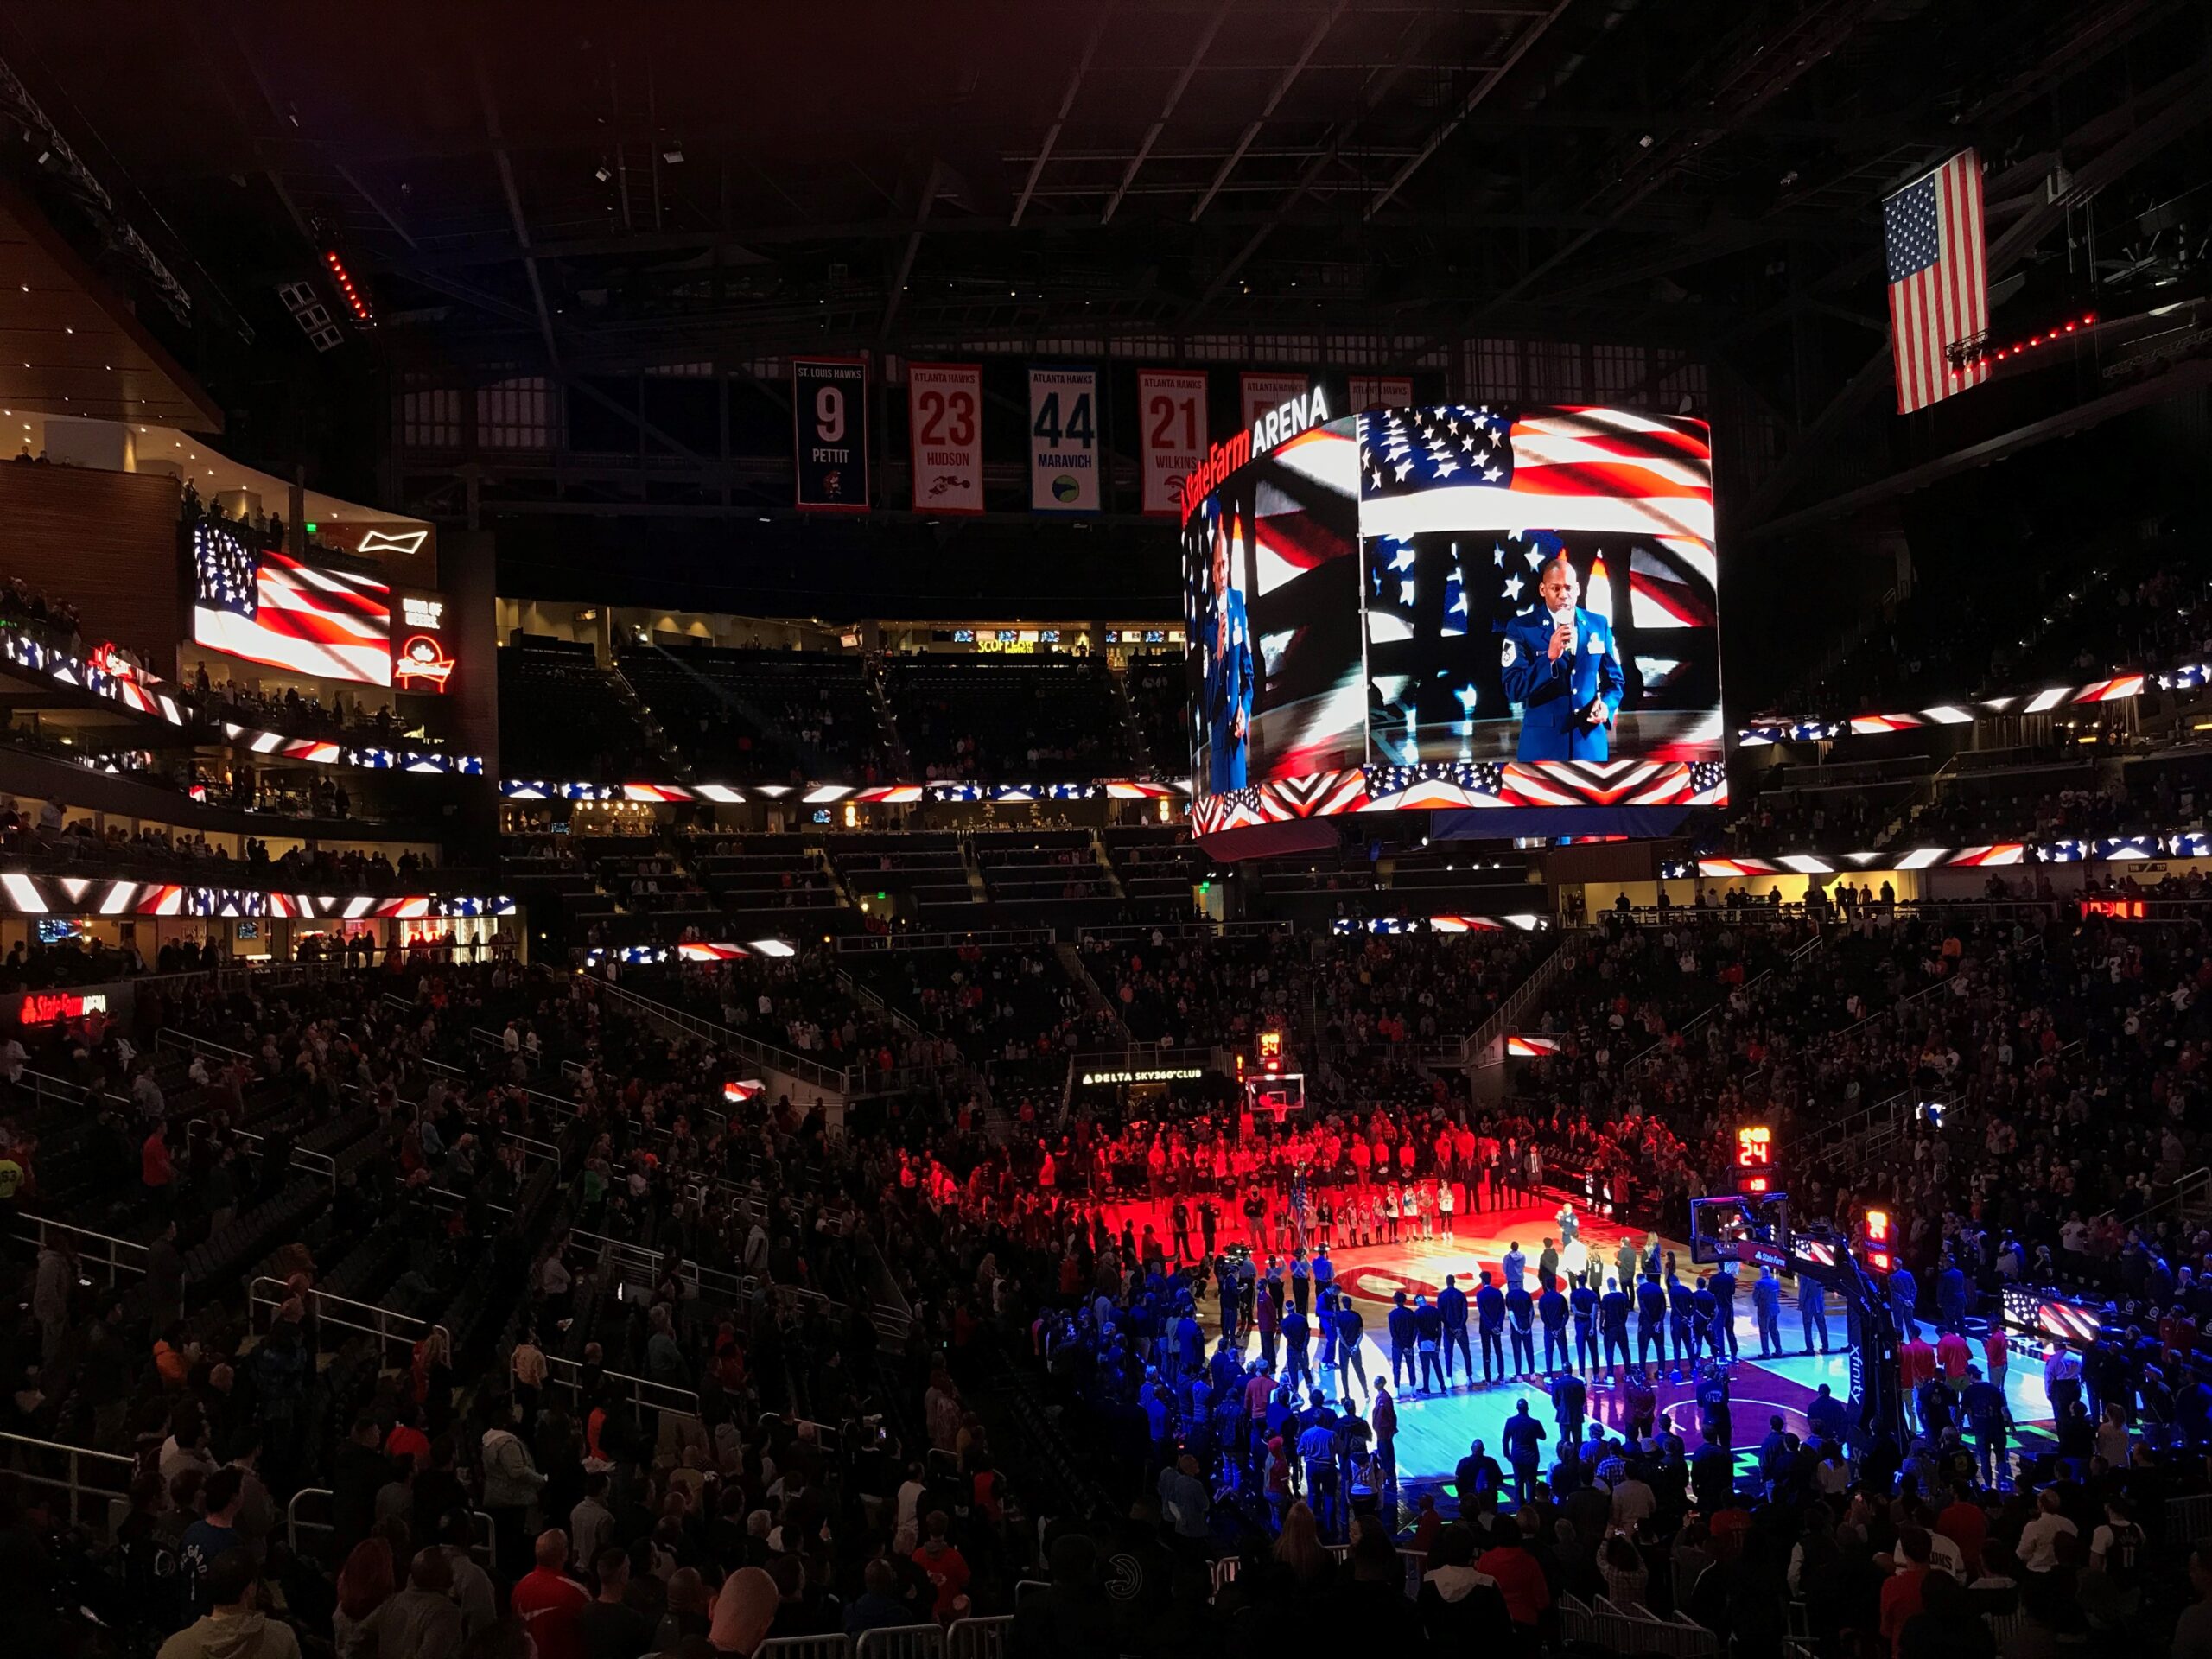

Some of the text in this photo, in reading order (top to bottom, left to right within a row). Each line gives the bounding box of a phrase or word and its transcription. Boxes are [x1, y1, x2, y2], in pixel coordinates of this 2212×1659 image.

[798, 366, 862, 380] ST. LOUIS HAWKS
[914, 372, 976, 384] ATLANTA HAWKS
[1033, 374, 1093, 385] ATLANTA HAWKS
[1144, 378, 1202, 390] ATLANTA HAWKS
[1247, 382, 1304, 392] ATLANTA HAWKS
[1383, 386, 1408, 395] HAWKS
[815, 385, 847, 443] 9
[919, 391, 976, 447] 23
[1034, 391, 1095, 448] 44
[1252, 385, 1329, 459] ARENA
[1150, 396, 1197, 450] 21
[812, 447, 850, 464] PETTIT
[926, 451, 969, 467] HUDSON
[1038, 453, 1092, 468] MARAVICH
[1155, 454, 1198, 470] WILKINS
[1262, 1043, 1278, 1056] 24
[1094, 1073, 1132, 1083] DELTA
[1739, 1142, 1767, 1166] 24
[1848, 1343, 1865, 1405] xfinity
